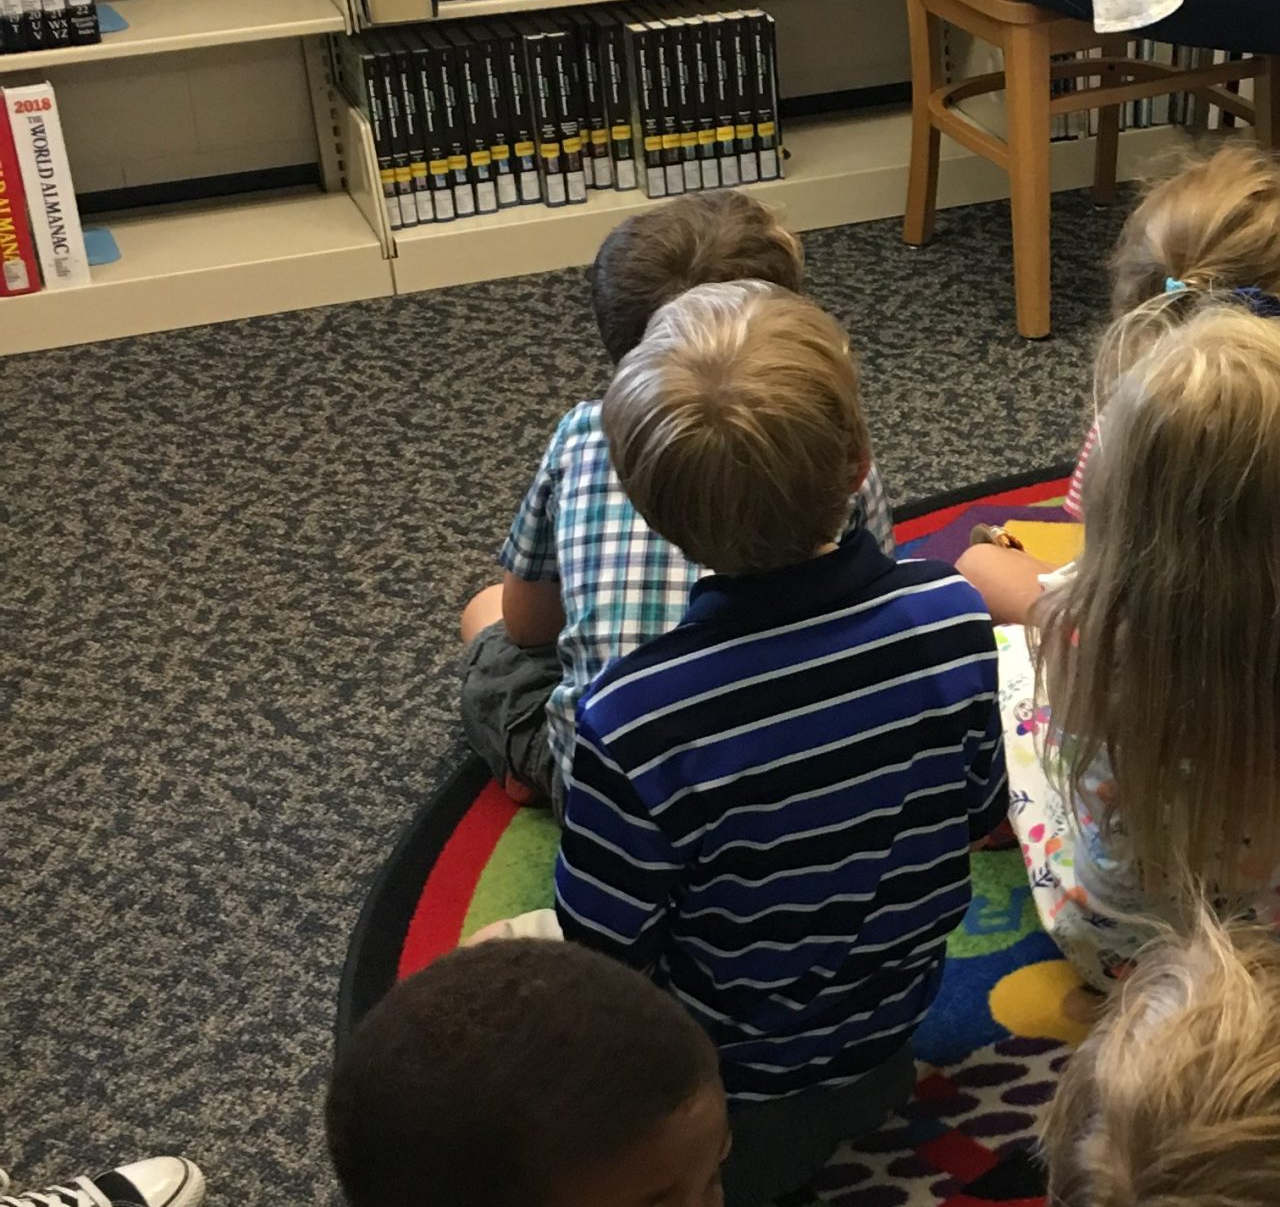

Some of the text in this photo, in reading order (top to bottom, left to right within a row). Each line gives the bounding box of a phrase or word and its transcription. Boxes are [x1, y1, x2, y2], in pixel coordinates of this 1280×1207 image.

[12, 24, 19, 33] T
[32, 21, 41, 30] U
[48, 19, 68, 29] WX
[33, 31, 42, 40] V
[52, 29, 68, 39] YZ
[14, 97, 52, 114] 2018
[27, 116, 44, 124] THE
[29, 123, 54, 179] WORLD
[40, 181, 71, 256] ALMANAC
